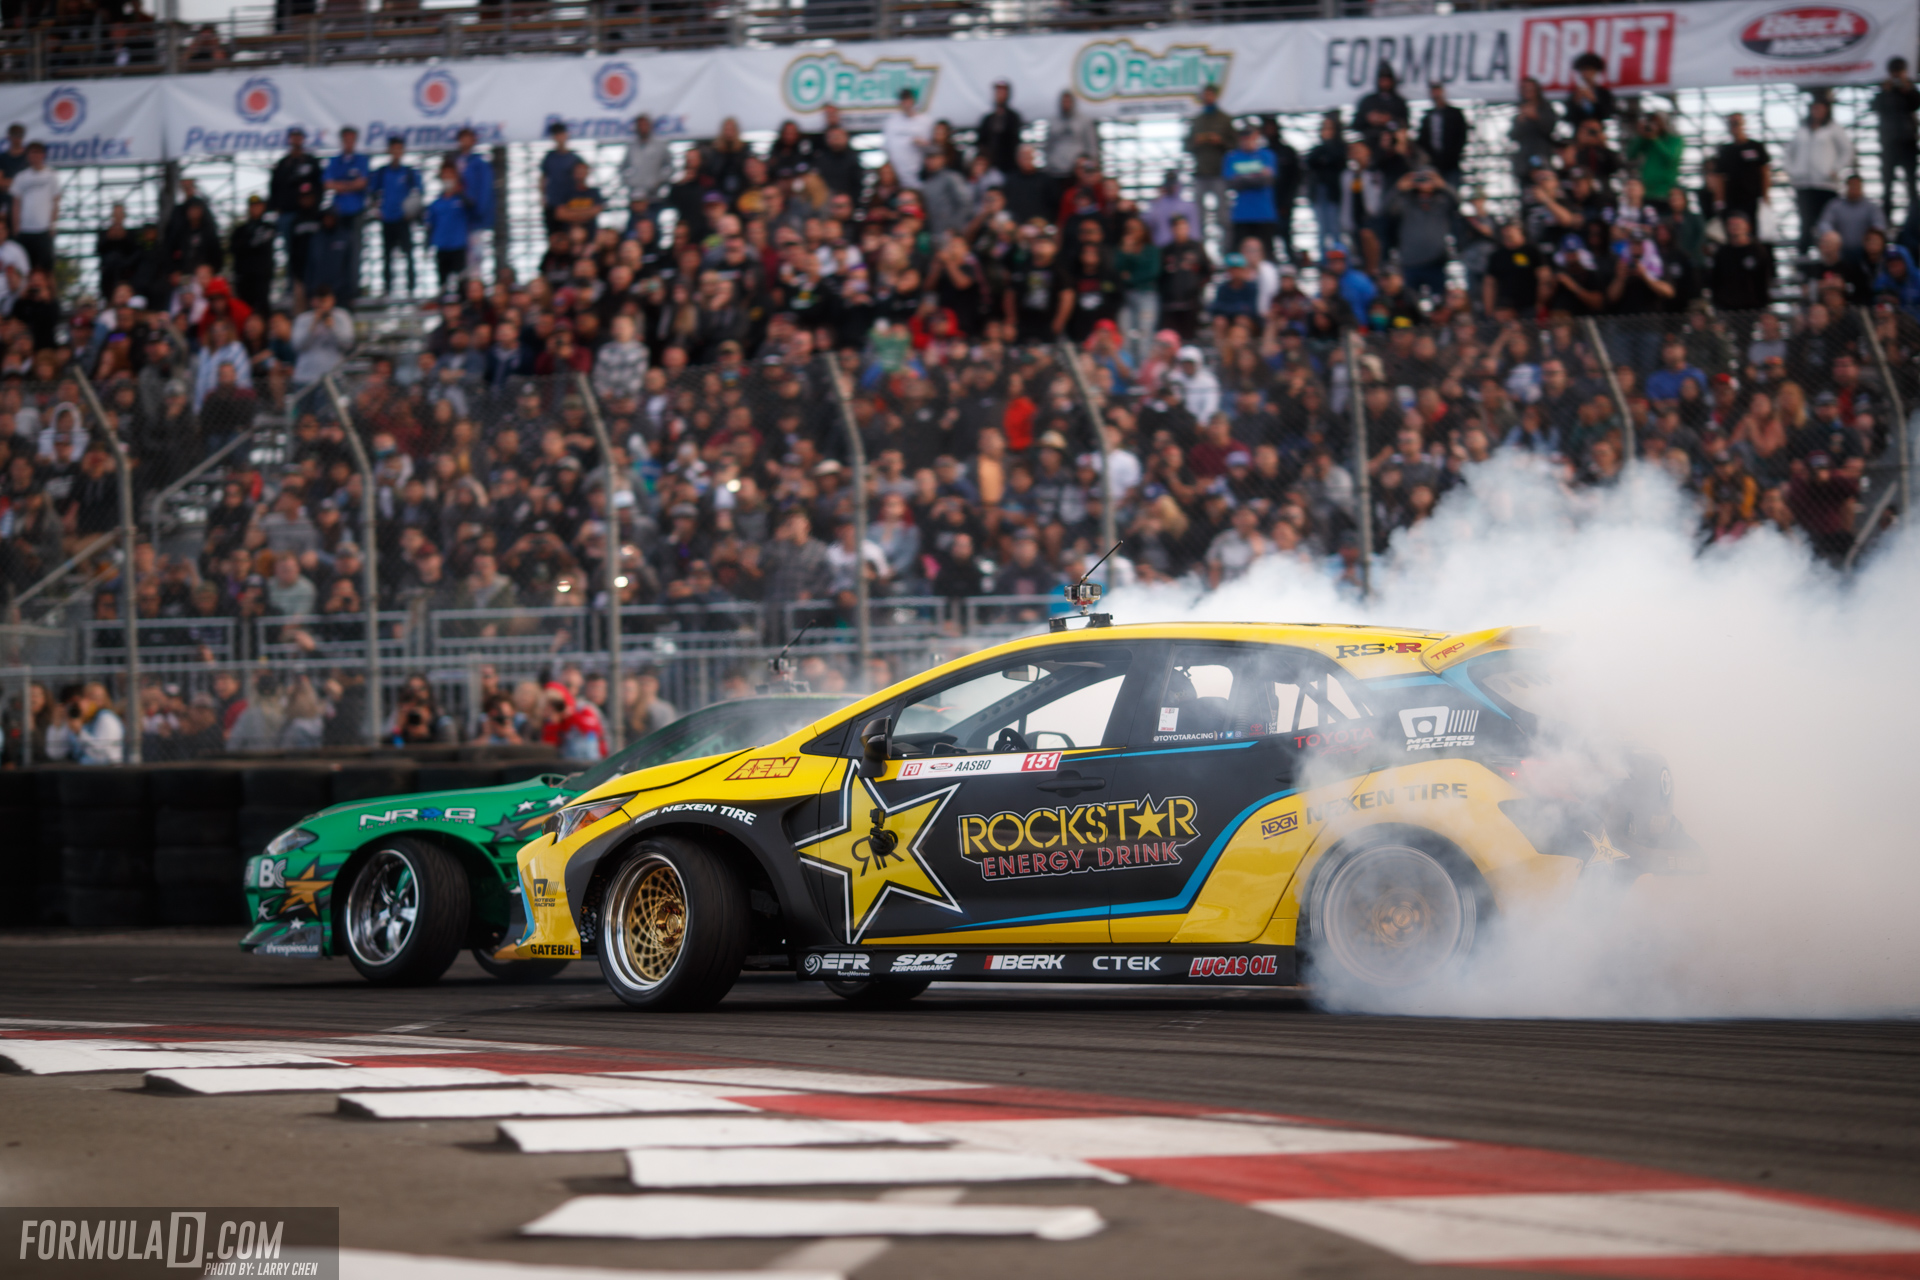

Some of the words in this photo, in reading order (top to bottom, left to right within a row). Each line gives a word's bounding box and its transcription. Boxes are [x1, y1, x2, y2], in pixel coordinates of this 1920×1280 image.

[1527, 14, 1669, 87] DRIFT
[365, 118, 506, 146] Prmaex
[541, 113, 688, 138] Permaex
[183, 125, 328, 153] Permax
[1430, 642, 1465, 661] TRD
[1153, 732, 1214, 742] @TOYOTARACING
[1293, 727, 1375, 749] TOYOTA
[1406, 735, 1476, 745] MOTEGI
[1406, 740, 1476, 752] RACING
[723, 756, 801, 781] AEM
[903, 764, 921, 776] FD
[954, 759, 992, 772] AASBO
[1025, 752, 1061, 770] 151
[1306, 788, 1395, 825] NEXEN
[1403, 783, 1468, 801] TIRE
[359, 807, 476, 827] NRG
[660, 803, 718, 814] NEXEN
[720, 805, 757, 826] TIRE
[1261, 811, 1299, 840] NEXEN
[983, 848, 1085, 877] ENERGY
[1097, 841, 1178, 867] DRINK
[530, 944, 576, 956] GATEBIL
[892, 953, 958, 966] SPC
[821, 953, 871, 970] EFR
[890, 964, 953, 973] PERFORMANCE
[1000, 954, 1066, 970] BERK
[1092, 956, 1162, 971] CTEK
[1188, 957, 1249, 978] LUCAS
[1248, 955, 1278, 975] OIL
